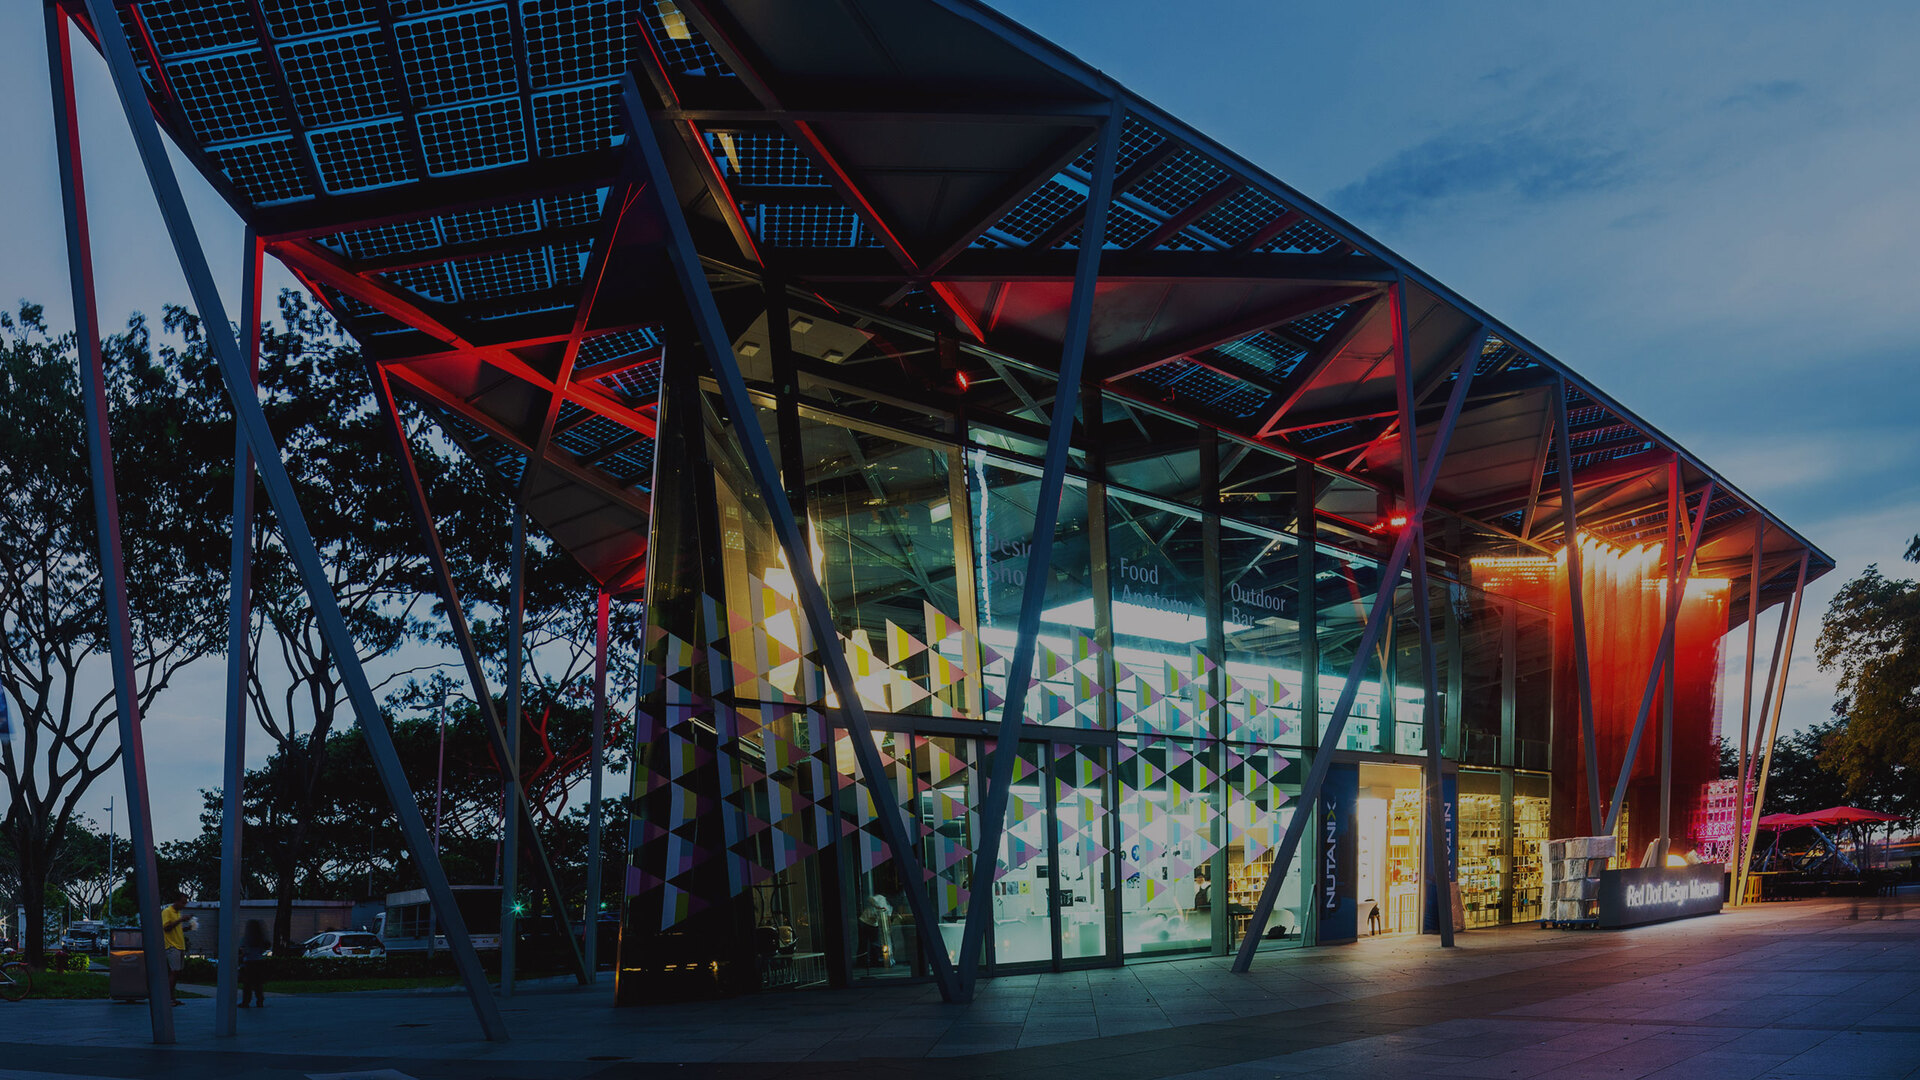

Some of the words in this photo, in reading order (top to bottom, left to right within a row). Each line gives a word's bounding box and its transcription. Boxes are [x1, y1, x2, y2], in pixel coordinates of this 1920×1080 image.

[987, 559, 1025, 586] Sho
[1120, 557, 1159, 585] Food
[1122, 584, 1193, 621] Anatomy
[1231, 583, 1286, 612] Outdoor
[1232, 607, 1255, 627] Bar
[1326, 801, 1337, 909] NUTANIX
[1626, 884, 1645, 907] Red
[1646, 882, 1662, 905] Dot
[1663, 881, 1689, 906] Design
